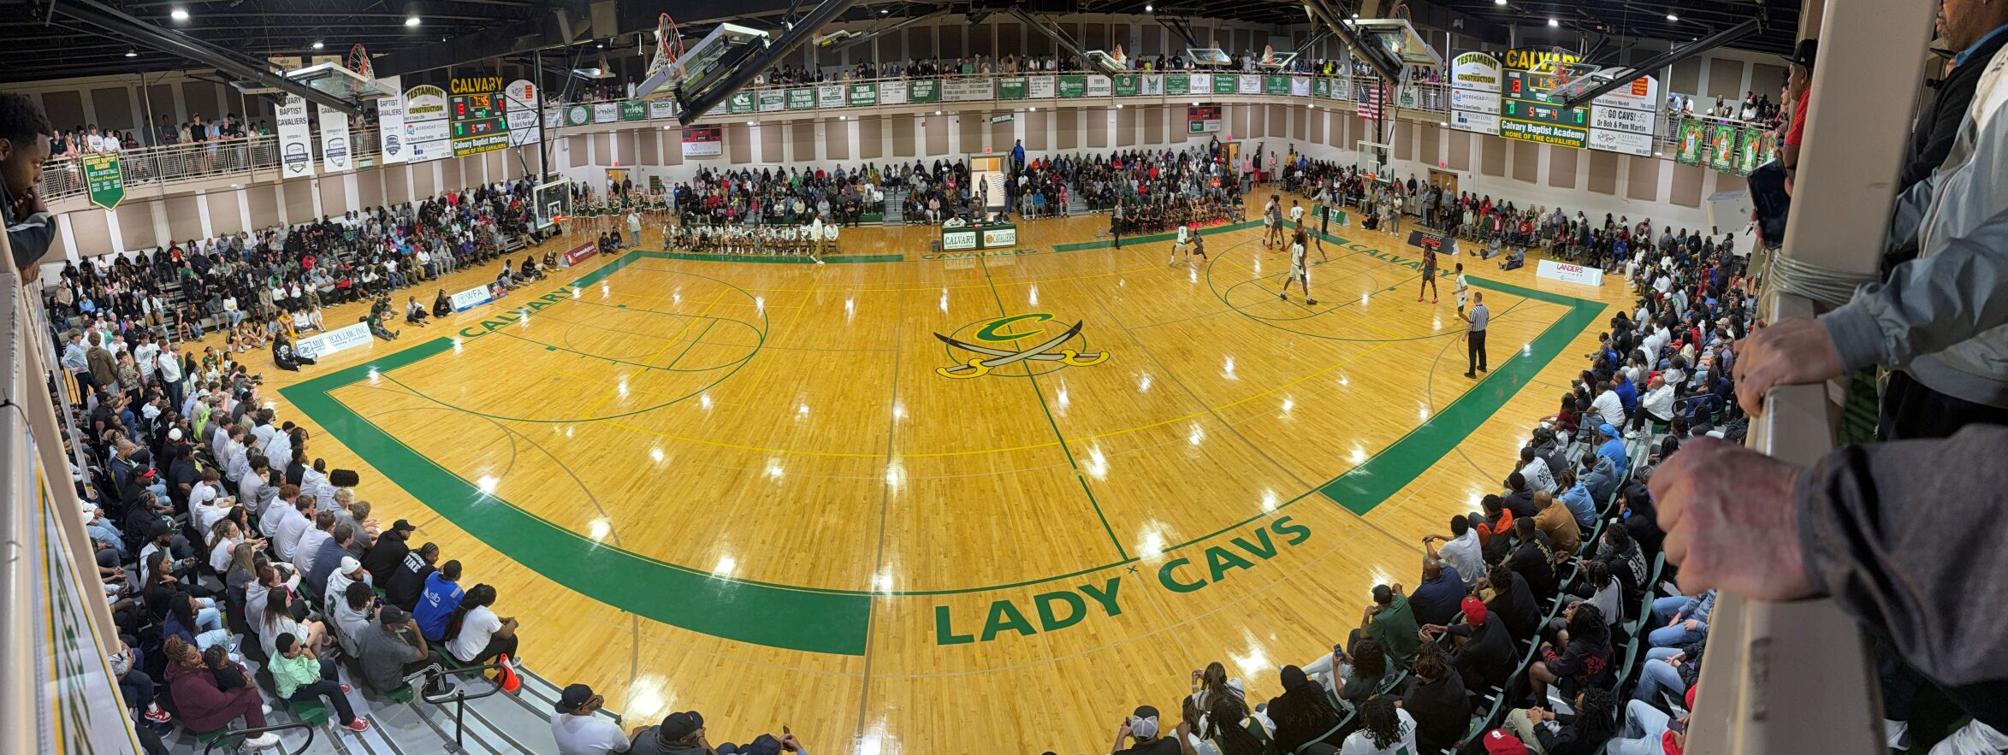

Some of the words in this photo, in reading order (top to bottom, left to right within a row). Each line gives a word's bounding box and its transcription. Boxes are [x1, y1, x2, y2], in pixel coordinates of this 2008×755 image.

[1457, 53, 1498, 70] TESTAMENT
[451, 76, 503, 94] CALVARY
[1457, 74, 1496, 85] CONSTRUCTION
[406, 86, 444, 102] TESTAMENT
[379, 99, 399, 107] BAPTIST
[279, 107, 302, 116] BAPTIST
[379, 109, 402, 117] CAVALIERS
[409, 105, 444, 114] CONSTRUCTION
[1608, 109, 1617, 118] GO
[1618, 110, 1637, 121] CAVS!
[278, 117, 307, 127] CAVALIERS
[1603, 120, 1613, 128] Bob
[1618, 122, 1629, 130] Pam
[1630, 123, 1647, 132] Martin
[1501, 119, 1526, 132] Calvary
[1527, 123, 1553, 135] Baptist
[1553, 128, 1585, 141] Academy
[1505, 131, 1522, 139] HOME
[1545, 136, 1581, 147] CAVALIERS
[945, 235, 975, 245] CALVARY
[1557, 263, 1584, 274] LANDERS
[459, 287, 574, 338] CALVARY
[403, 554, 421, 574] FIRE
[934, 576, 1122, 646] LADY
[1157, 514, 1312, 594] CAVS
